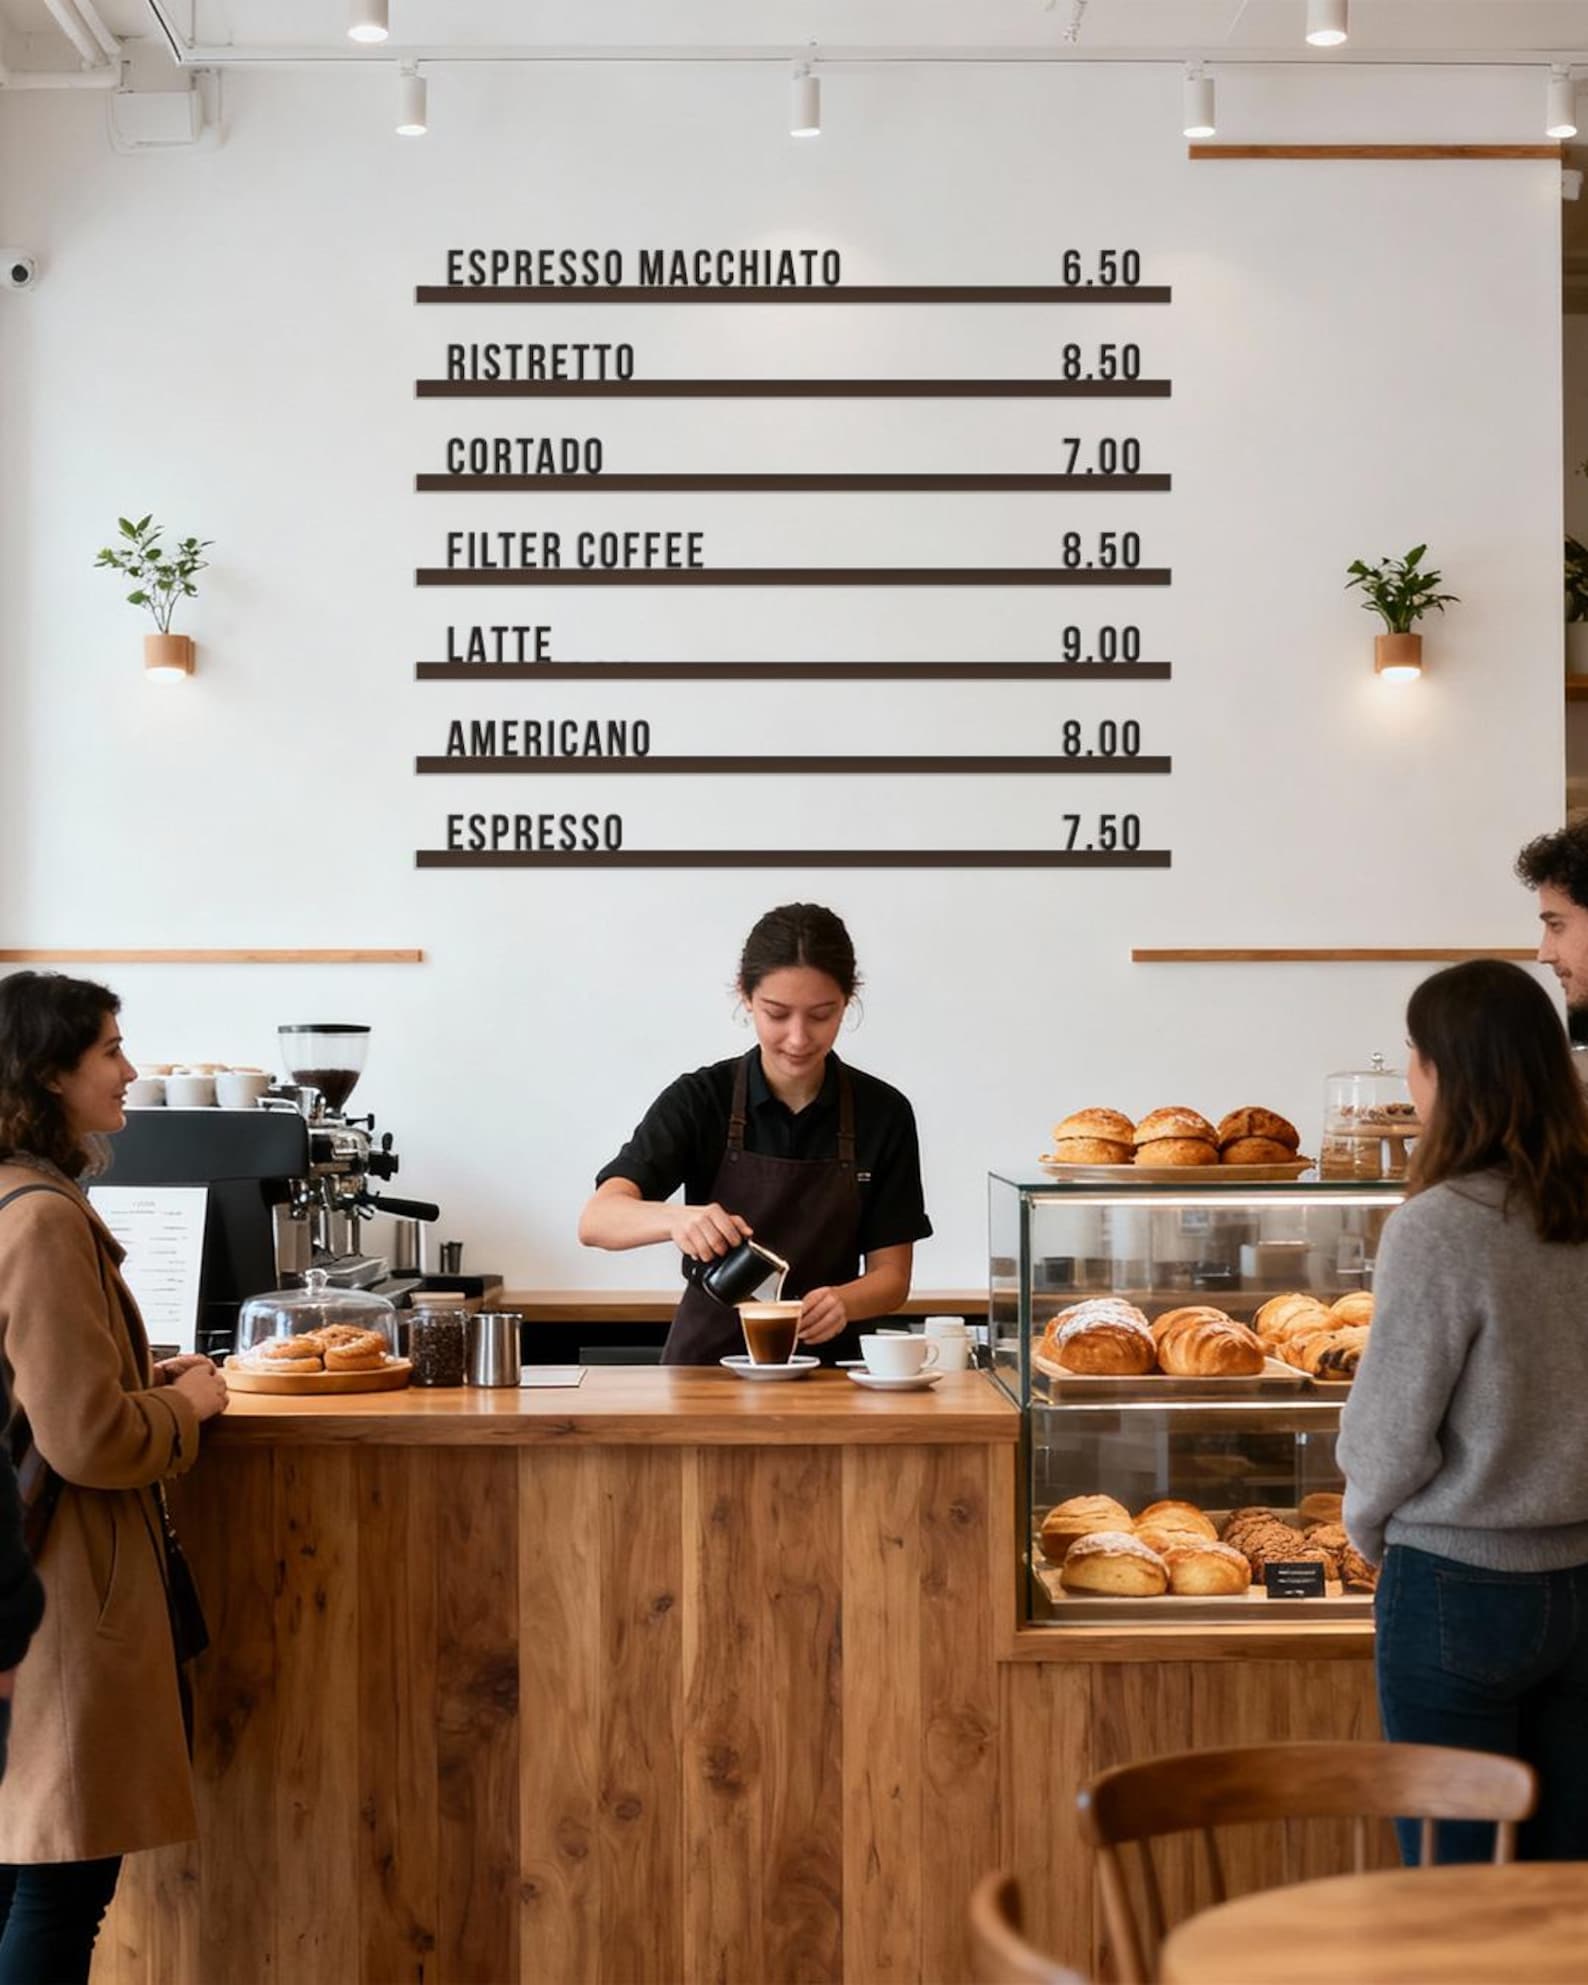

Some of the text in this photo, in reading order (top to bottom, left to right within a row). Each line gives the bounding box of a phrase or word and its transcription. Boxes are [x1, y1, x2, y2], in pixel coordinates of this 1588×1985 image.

[447, 249, 1141, 287] ESPRESSO MACCHIATO 6.50
[447, 343, 1141, 381] RISTRETTO 8.50
[447, 437, 1141, 475] CORTADO 7.00
[447, 531, 1141, 569] FILTER COFFEE 8.50
[447, 626, 1141, 663] LATTE 9.00
[446, 719, 1141, 757] AMERICANO 8.00
[447, 813, 1141, 851] ESPRESSO 7.50
